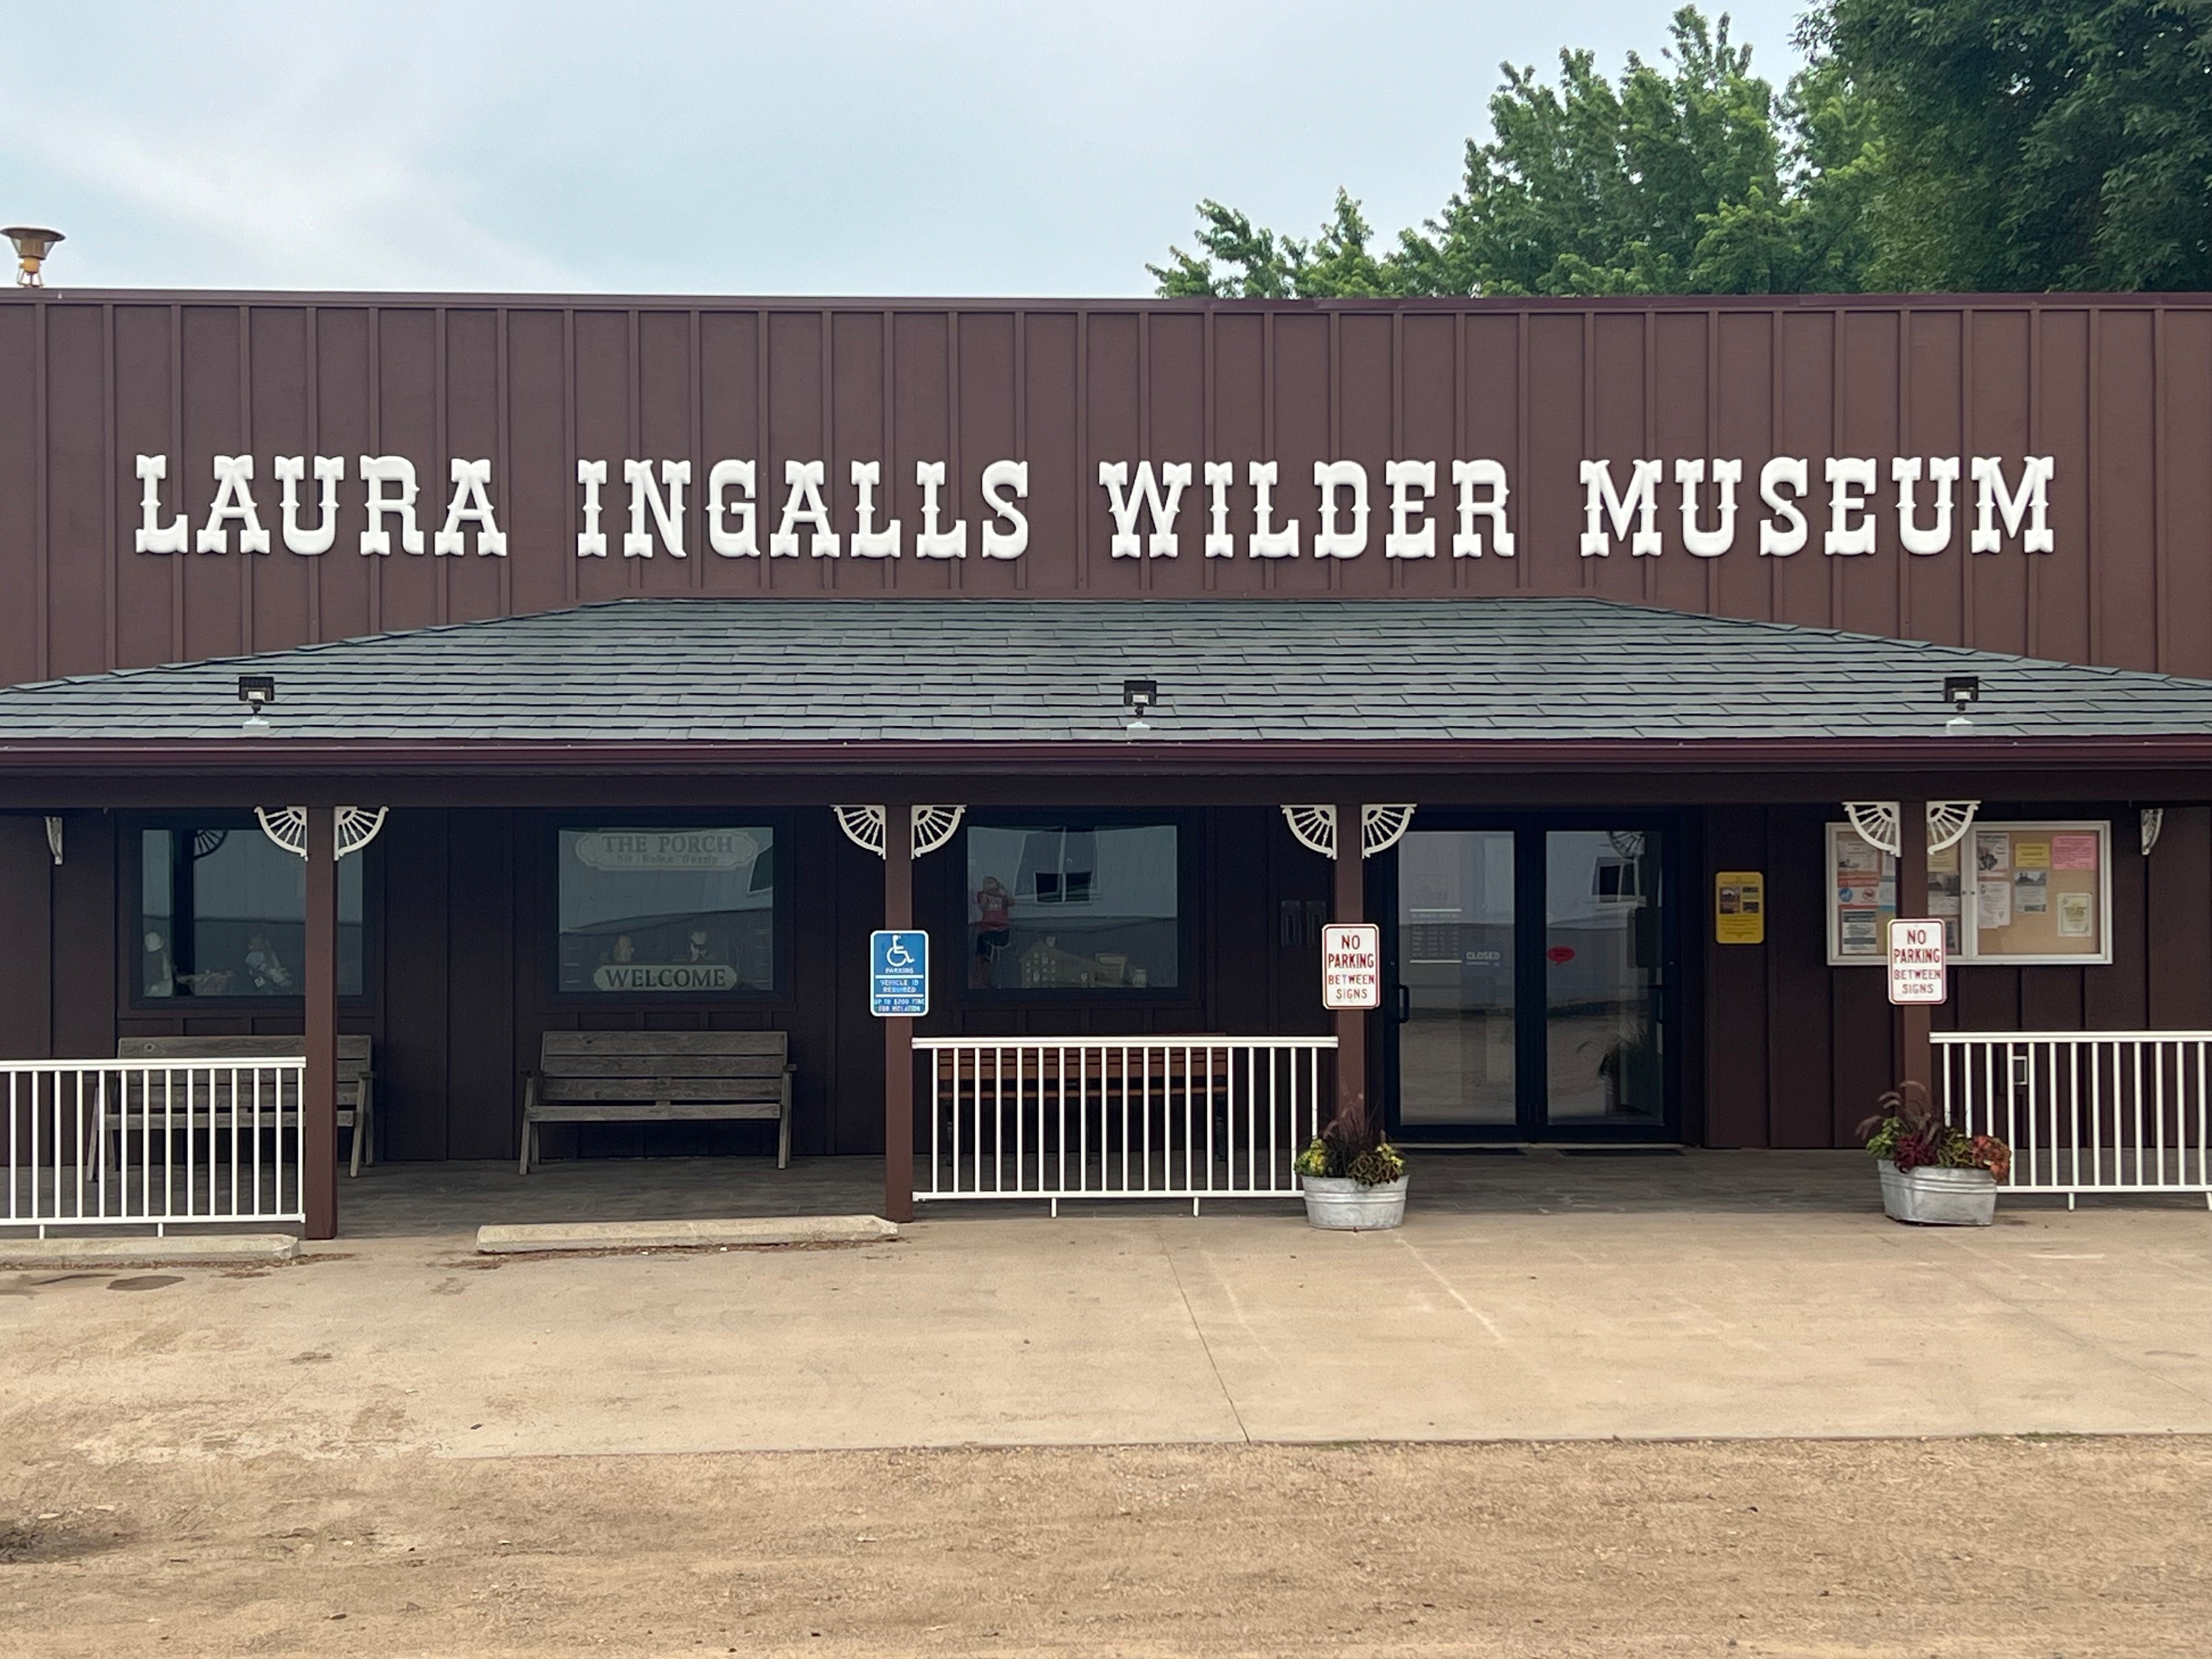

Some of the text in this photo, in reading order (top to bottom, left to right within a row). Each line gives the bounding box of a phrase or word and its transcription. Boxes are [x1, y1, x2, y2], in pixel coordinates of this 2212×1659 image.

[135, 454, 2054, 558] LAURA INGALLS WILDER MUSEUM
[602, 835, 733, 853] THE PORCH
[1341, 935, 1361, 950] NO
[1906, 929, 1926, 945] NO
[1328, 953, 1374, 969] PARKING
[1466, 951, 1501, 960] CLOSED
[1893, 949, 1940, 963] PARKING
[606, 969, 726, 988] WELCOME
[1328, 974, 1375, 985] BETWEEN
[1893, 969, 1941, 980] BETWEEN
[1336, 988, 1368, 999] SIGNS
[1901, 984, 1934, 994] SIGNS
